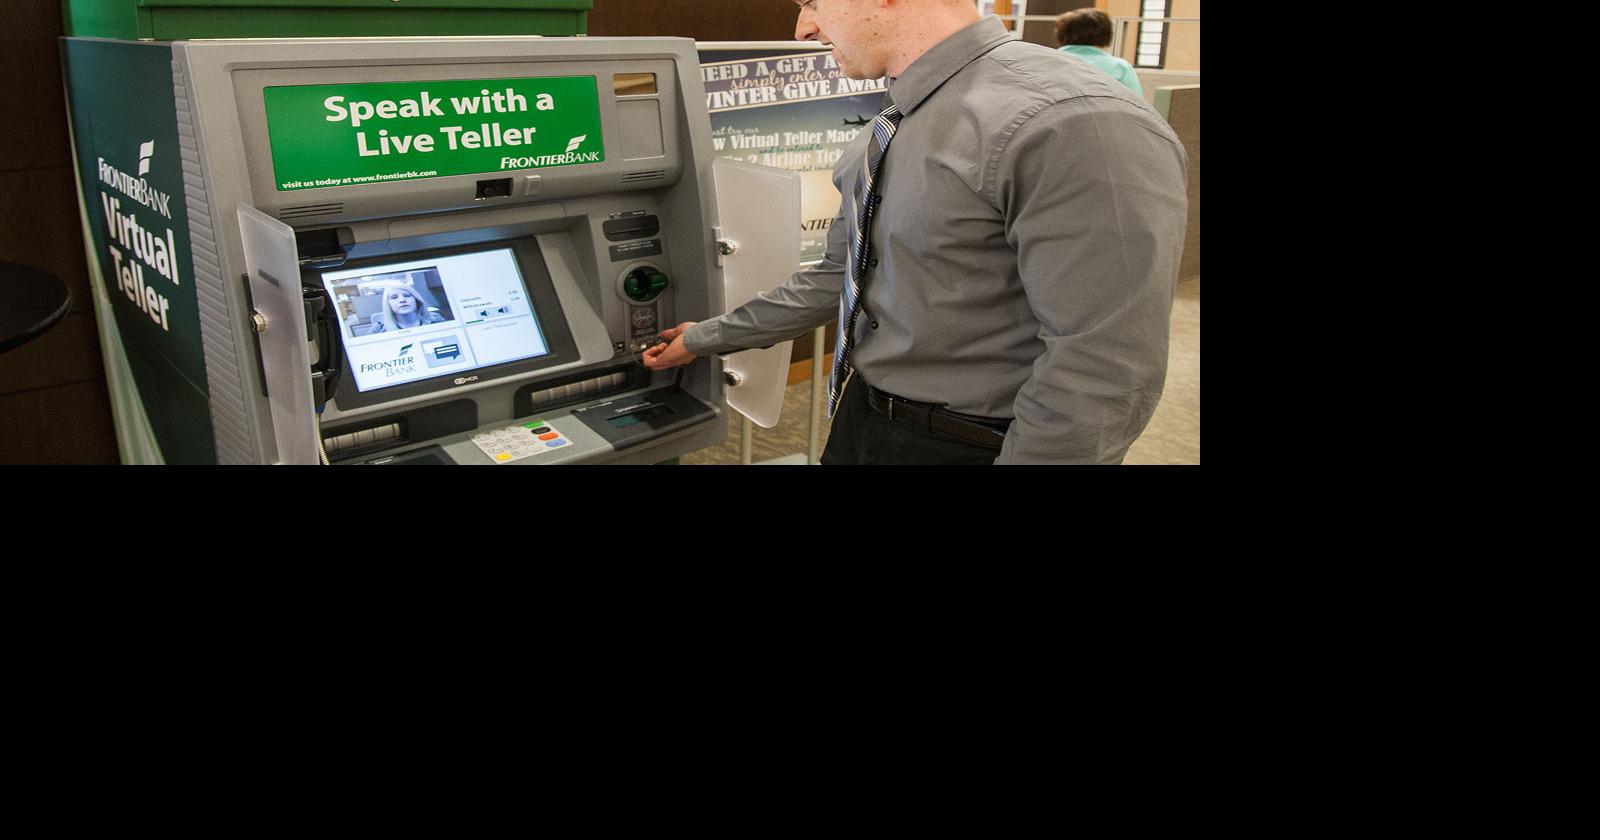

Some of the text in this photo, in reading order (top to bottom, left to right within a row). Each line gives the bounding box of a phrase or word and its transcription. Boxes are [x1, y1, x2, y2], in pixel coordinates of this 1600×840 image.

[755, 61, 770, 77] A
[776, 56, 817, 74] GET
[730, 69, 785, 91] simply
[789, 70, 826, 84] enter
[783, 80, 831, 100] GIVE
[324, 88, 555, 126] Speak with a
[356, 122, 536, 157] Live Teller
[730, 132, 779, 150] Virtual
[784, 131, 823, 146] Teller
[827, 128, 859, 144] Mach
[815, 149, 845, 164] Tick
[282, 181, 302, 189] visit
[316, 177, 341, 187] today
[352, 169, 437, 182] www.frontierbk.com
[101, 192, 179, 285] Virtual
[109, 245, 169, 331] Teller
[361, 356, 414, 373] FRONTIER
